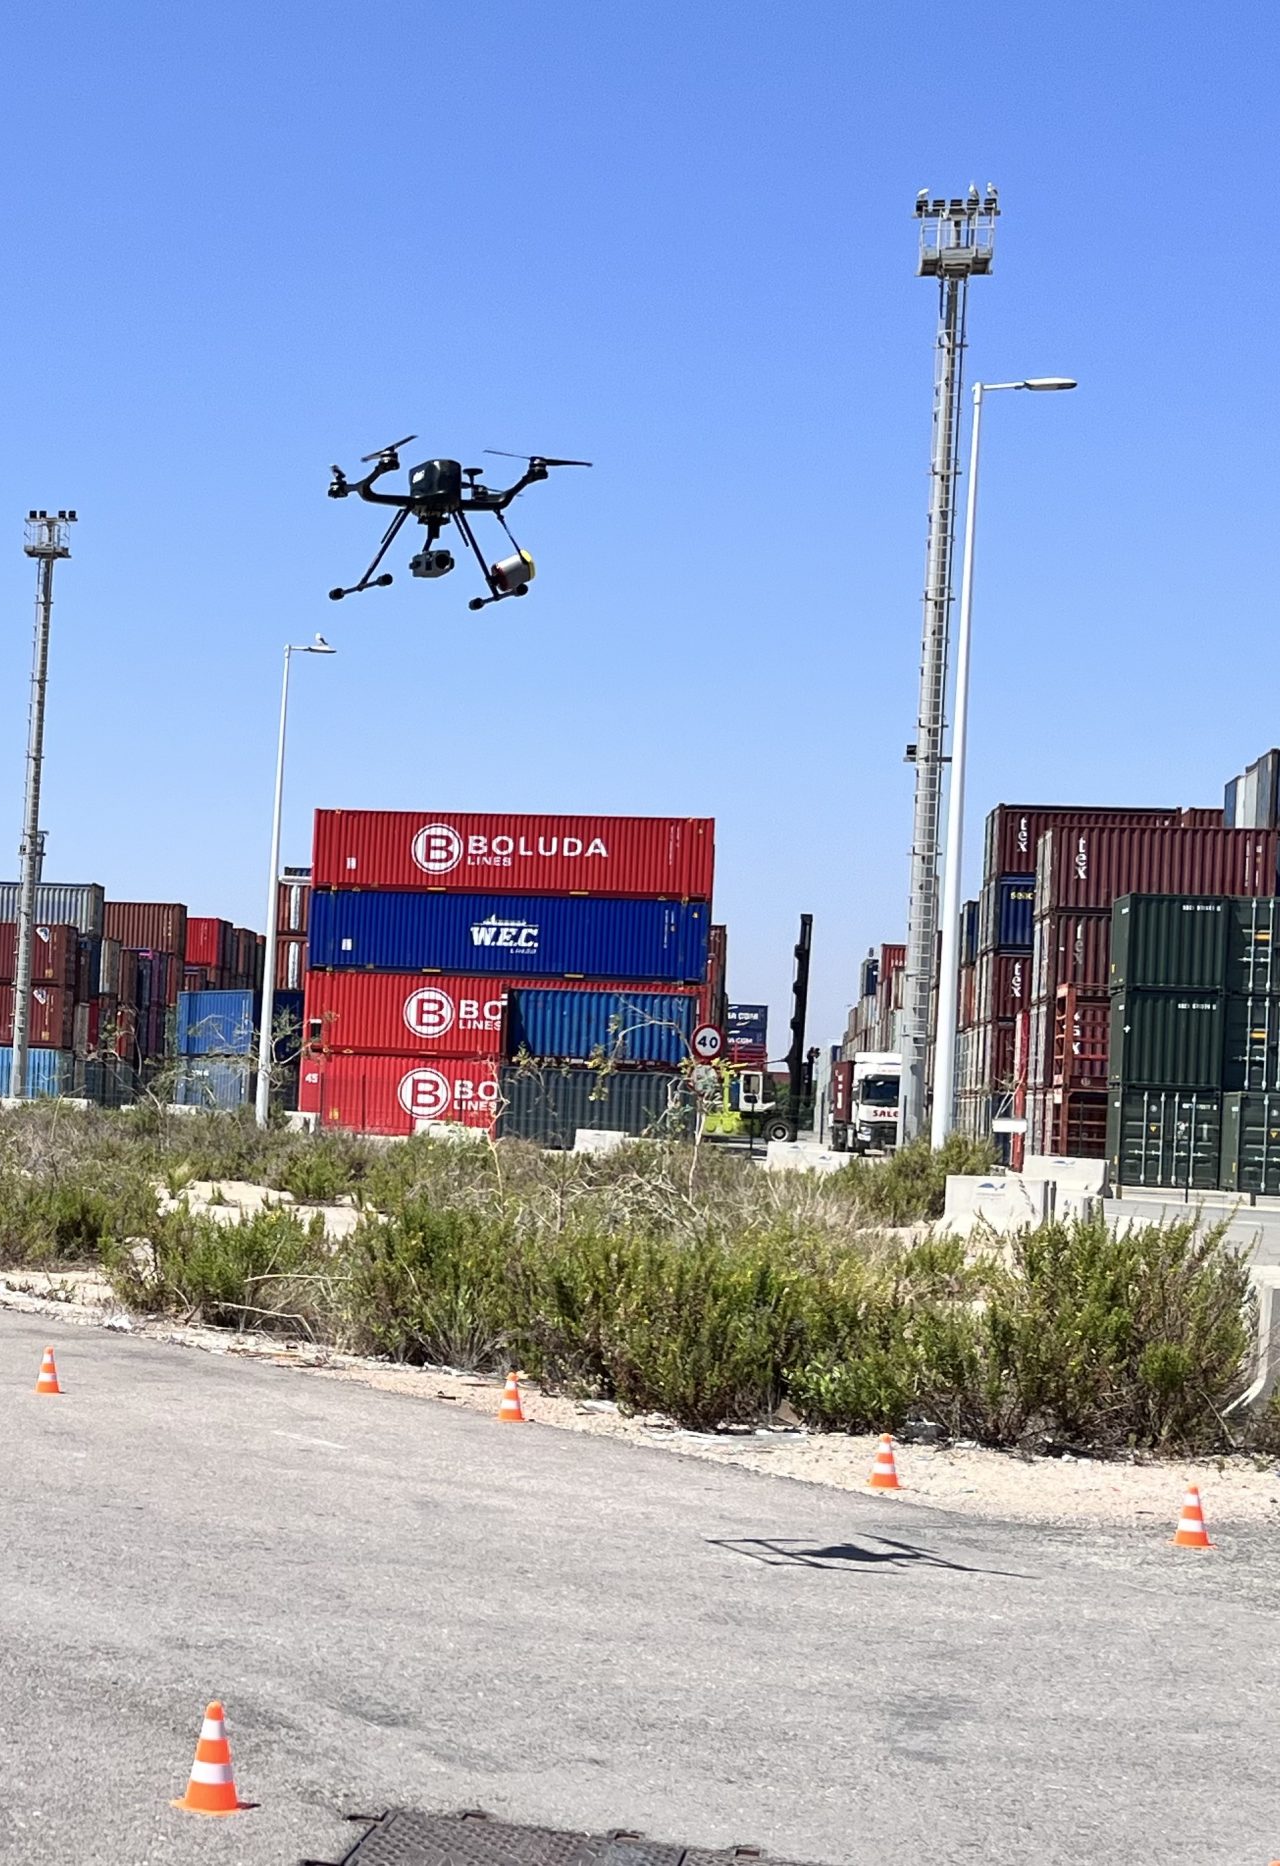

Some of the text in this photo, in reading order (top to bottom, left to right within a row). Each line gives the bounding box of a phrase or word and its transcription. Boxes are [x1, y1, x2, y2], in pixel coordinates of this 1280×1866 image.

[1017, 817, 1028, 852] tex
[468, 835, 609, 858] BOLUDA
[467, 856, 513, 867] LINES
[1074, 836, 1088, 880] tex
[1011, 962, 1022, 997] tex
[459, 1019, 501, 1031] LINES
[697, 1035, 718, 1049] 40
[305, 1073, 318, 1083] 45
[453, 1099, 497, 1111] LINES
